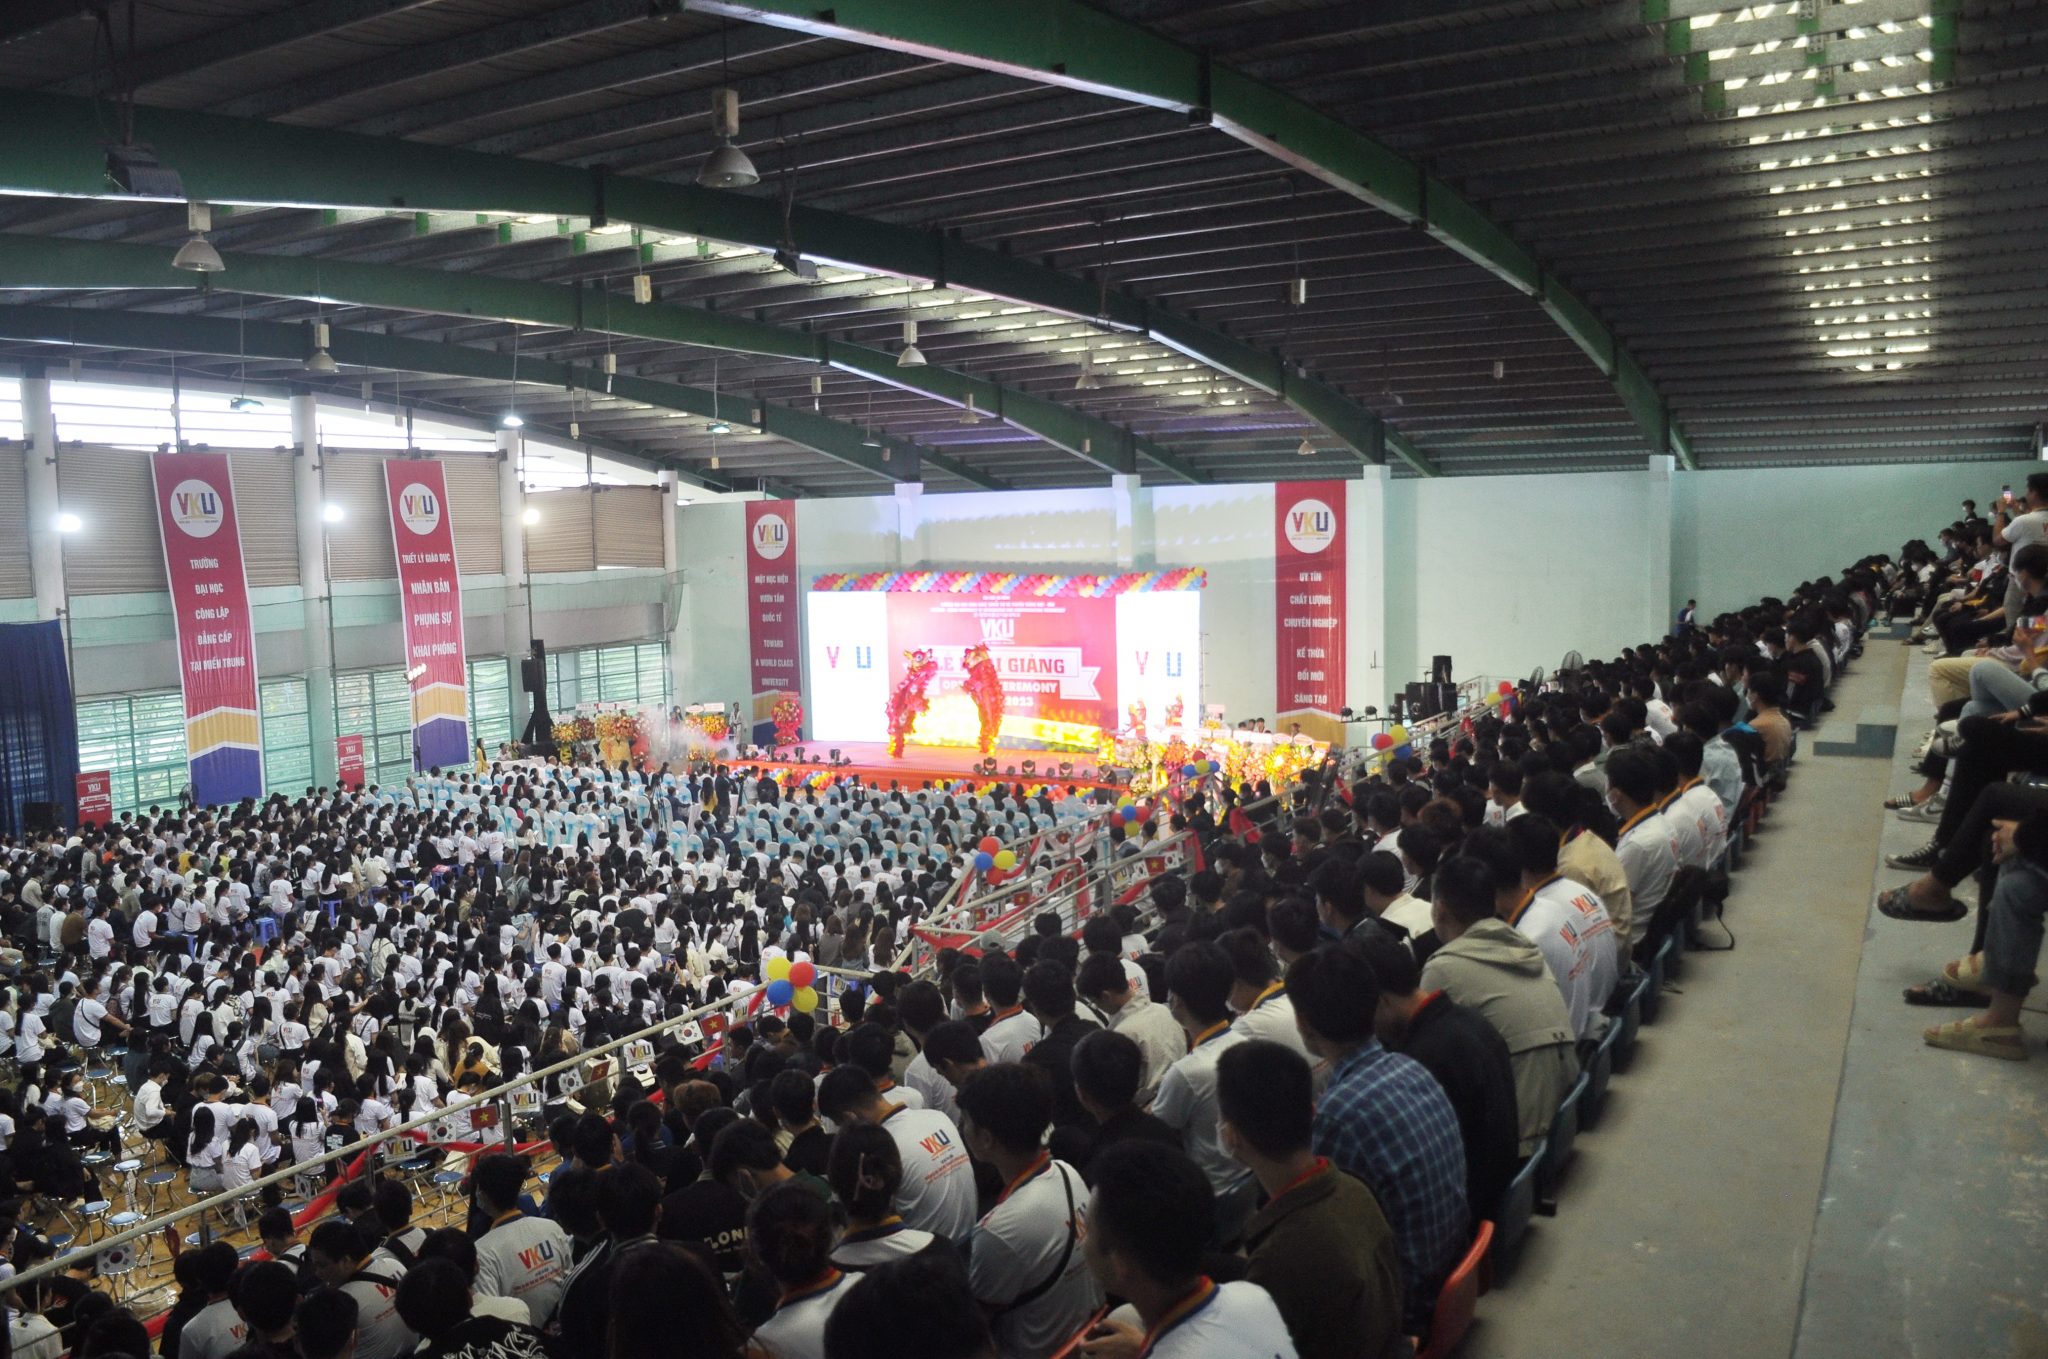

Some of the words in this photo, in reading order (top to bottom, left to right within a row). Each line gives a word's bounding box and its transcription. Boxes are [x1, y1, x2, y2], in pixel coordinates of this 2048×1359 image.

[176, 492, 217, 519] VKU
[404, 495, 434, 518] VKU
[1292, 511, 1329, 534] VKU
[757, 524, 784, 543] VKU
[189, 556, 219, 570] TRƯỜNG
[402, 553, 417, 564] TRIẾT
[425, 553, 439, 563] GIÁO
[439, 553, 451, 564] DỤC
[1299, 572, 1309, 582] UY
[1310, 571, 1322, 582] TÍN
[195, 582, 209, 596] ĐẠI
[209, 582, 224, 596] HỌC
[411, 580, 433, 595] NHÂN
[433, 576, 450, 594] BẢN
[1289, 592, 1308, 605] CHẤT
[1308, 594, 1332, 607] LƯỢNG
[195, 607, 216, 620] CÔNG
[216, 605, 230, 623] LẬP
[414, 613, 440, 629] PHỤNG
[441, 611, 453, 627] SỰ
[980, 618, 1015, 638] VKU
[1284, 617, 1311, 628] CHUYÊN
[1312, 617, 1338, 629] NGHIỆP
[197, 630, 217, 645] ĐẲNG
[218, 630, 233, 644] CẤP
[413, 646, 431, 658] KHAI
[432, 641, 457, 656] PHÓNG
[1296, 647, 1306, 658] KẾ
[1307, 647, 1325, 659] THỪA
[190, 661, 202, 673] TẠI
[202, 655, 222, 669] MIỀN
[222, 656, 246, 668] TRUNG
[1008, 652, 1065, 674] GIẢNG
[761, 678, 789, 687] UNIVERSITY
[1310, 670, 1324, 681] MỚI
[1004, 696, 1034, 707] 2023
[1294, 693, 1313, 704] SÁNG
[1313, 694, 1328, 706] TẠO
[87, 782, 101, 792] VKU
[1570, 892, 1598, 914] VKU
[629, 1045, 651, 1061] VKU
[513, 1092, 537, 1107] VKU
[386, 1136, 413, 1157] VKU
[919, 1128, 951, 1154] VKU
[518, 1239, 554, 1271] VKU
[229, 1323, 248, 1339] VK
